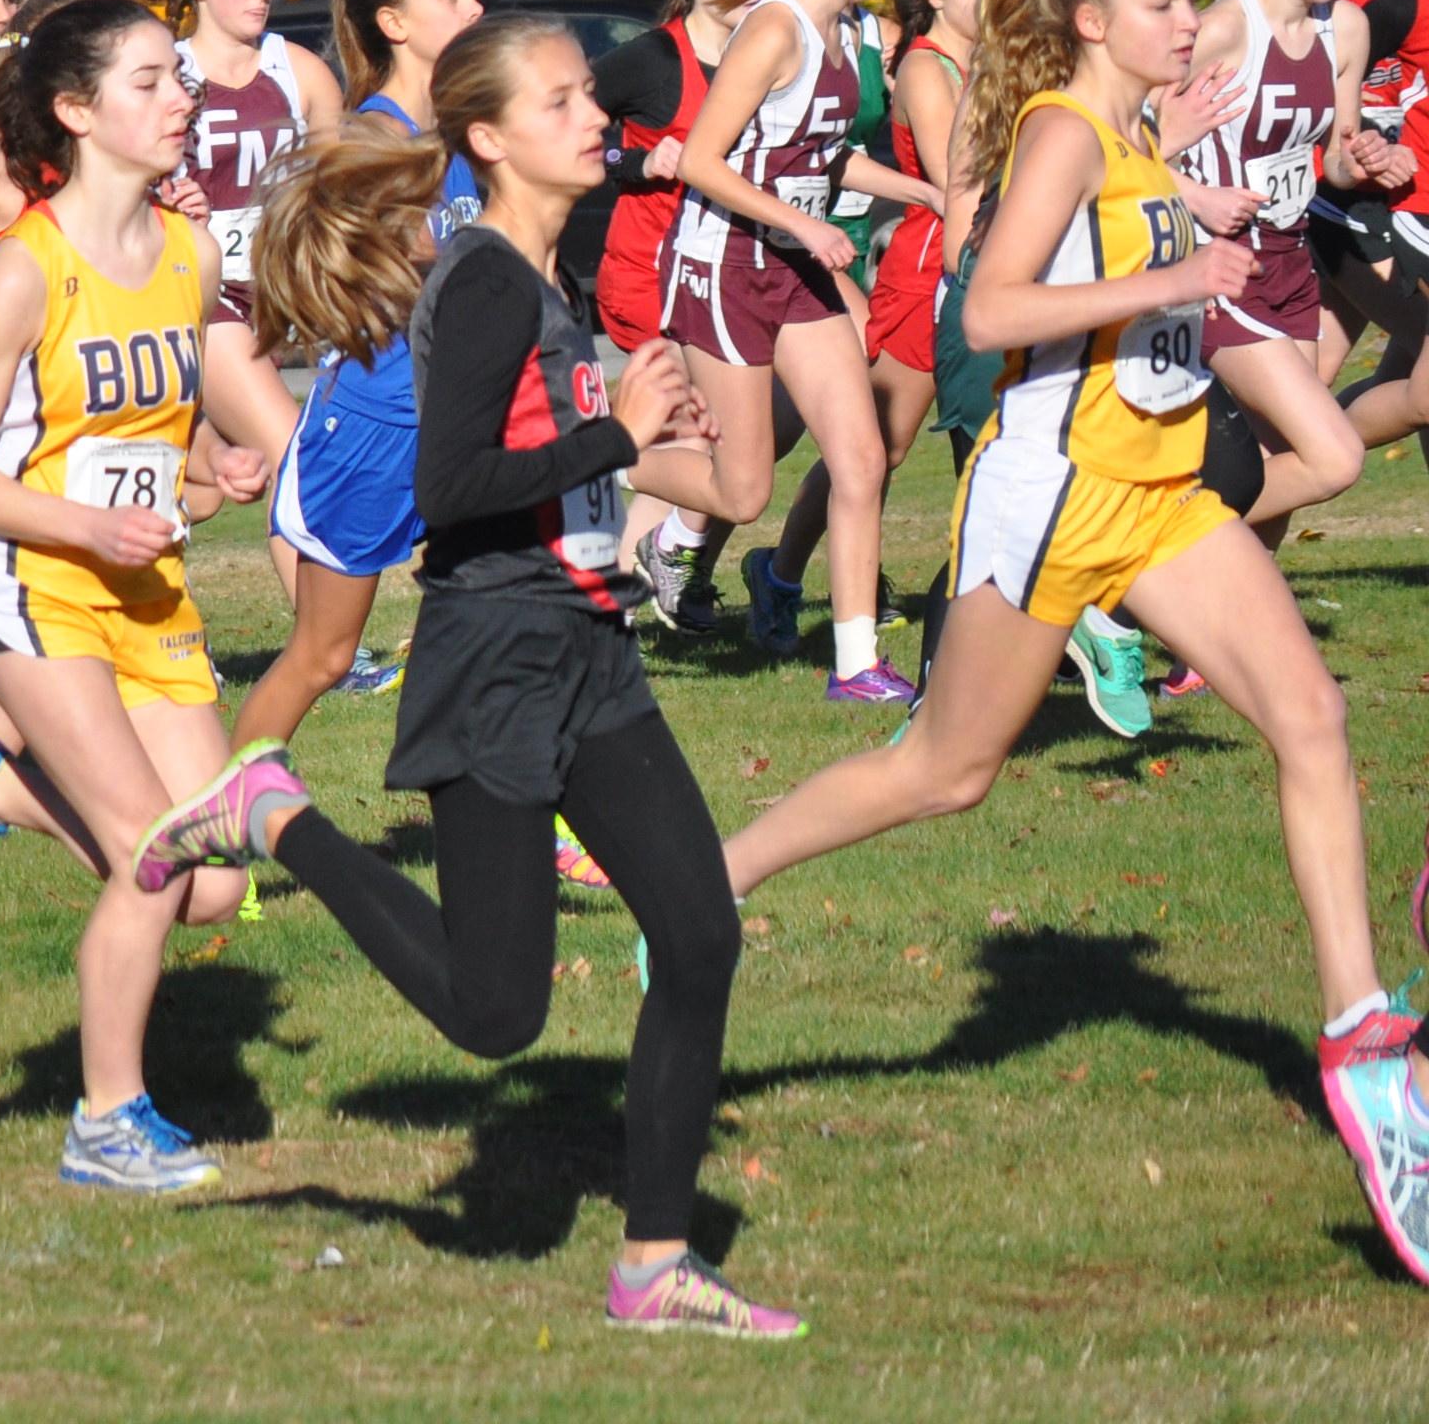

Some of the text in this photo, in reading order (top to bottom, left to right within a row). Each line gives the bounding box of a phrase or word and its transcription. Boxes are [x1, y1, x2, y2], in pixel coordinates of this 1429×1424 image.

[1267, 164, 1307, 207] 217
[681, 264, 708, 299] FM
[1151, 322, 1191, 374] 80
[77, 326, 201, 415] BOW
[104, 466, 157, 509] 78
